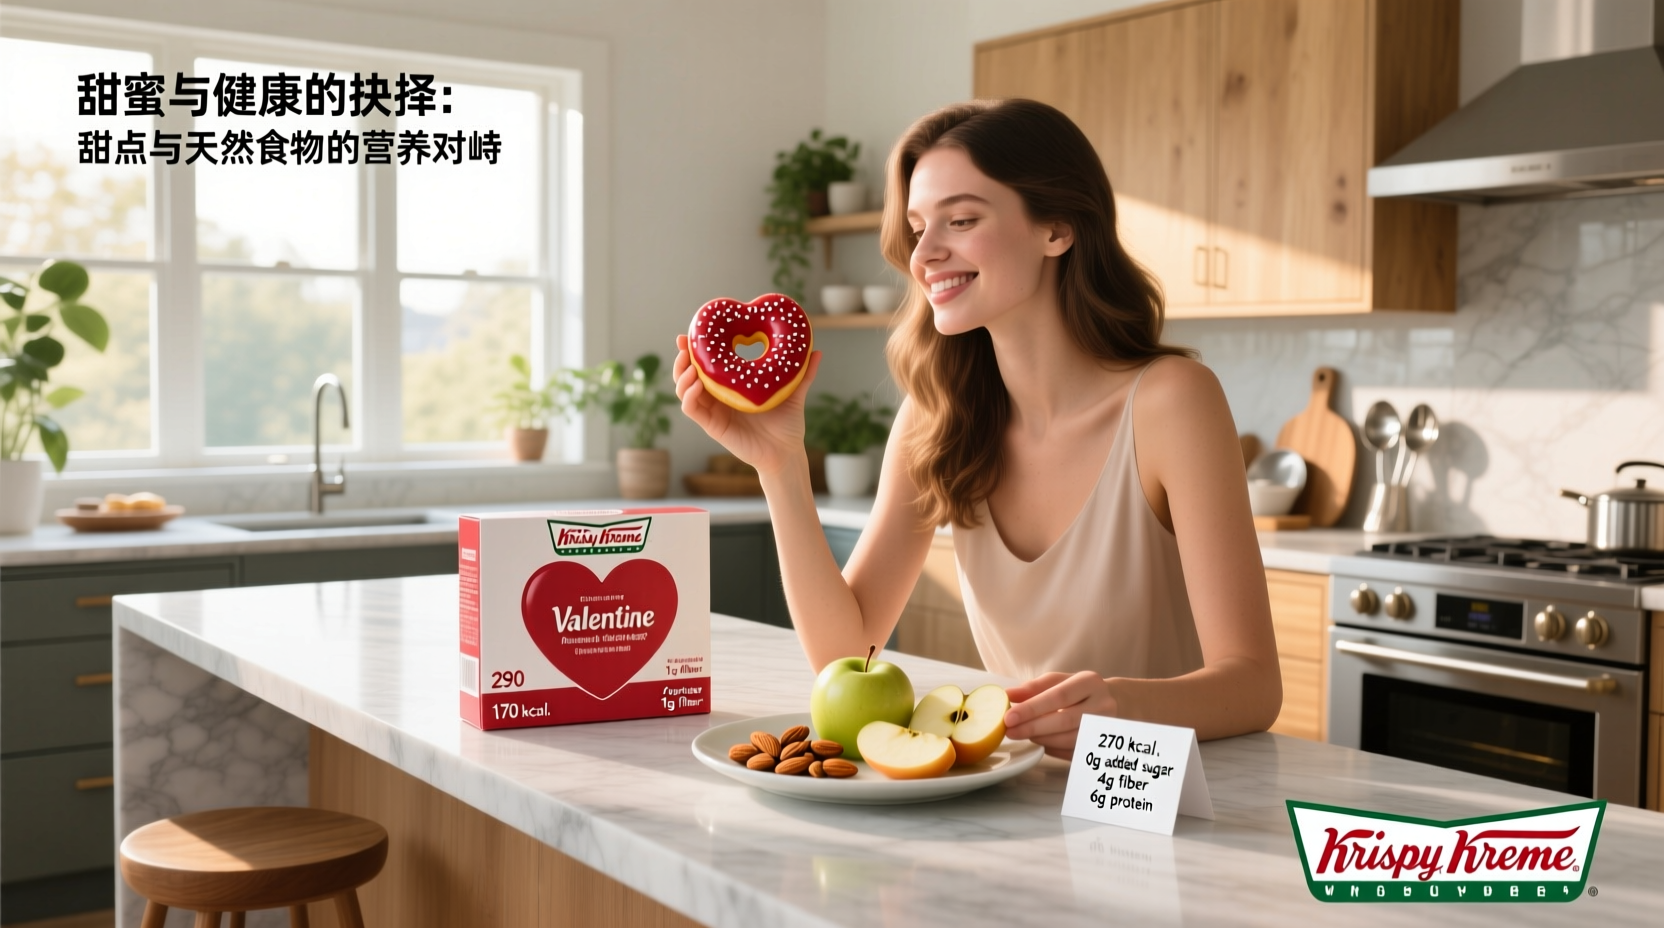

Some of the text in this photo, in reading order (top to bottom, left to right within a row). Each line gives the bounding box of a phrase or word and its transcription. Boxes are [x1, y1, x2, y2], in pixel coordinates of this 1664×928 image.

[552, 605, 655, 633] Valentine
[491, 670, 525, 689] 290
[492, 703, 519, 720] 170
[1098, 734, 1160, 757] 270 kcal.
[1085, 752, 1174, 779] 0g added sugar
[1097, 772, 1149, 791] 4g fiber
[1090, 789, 1153, 812] 6g protein
